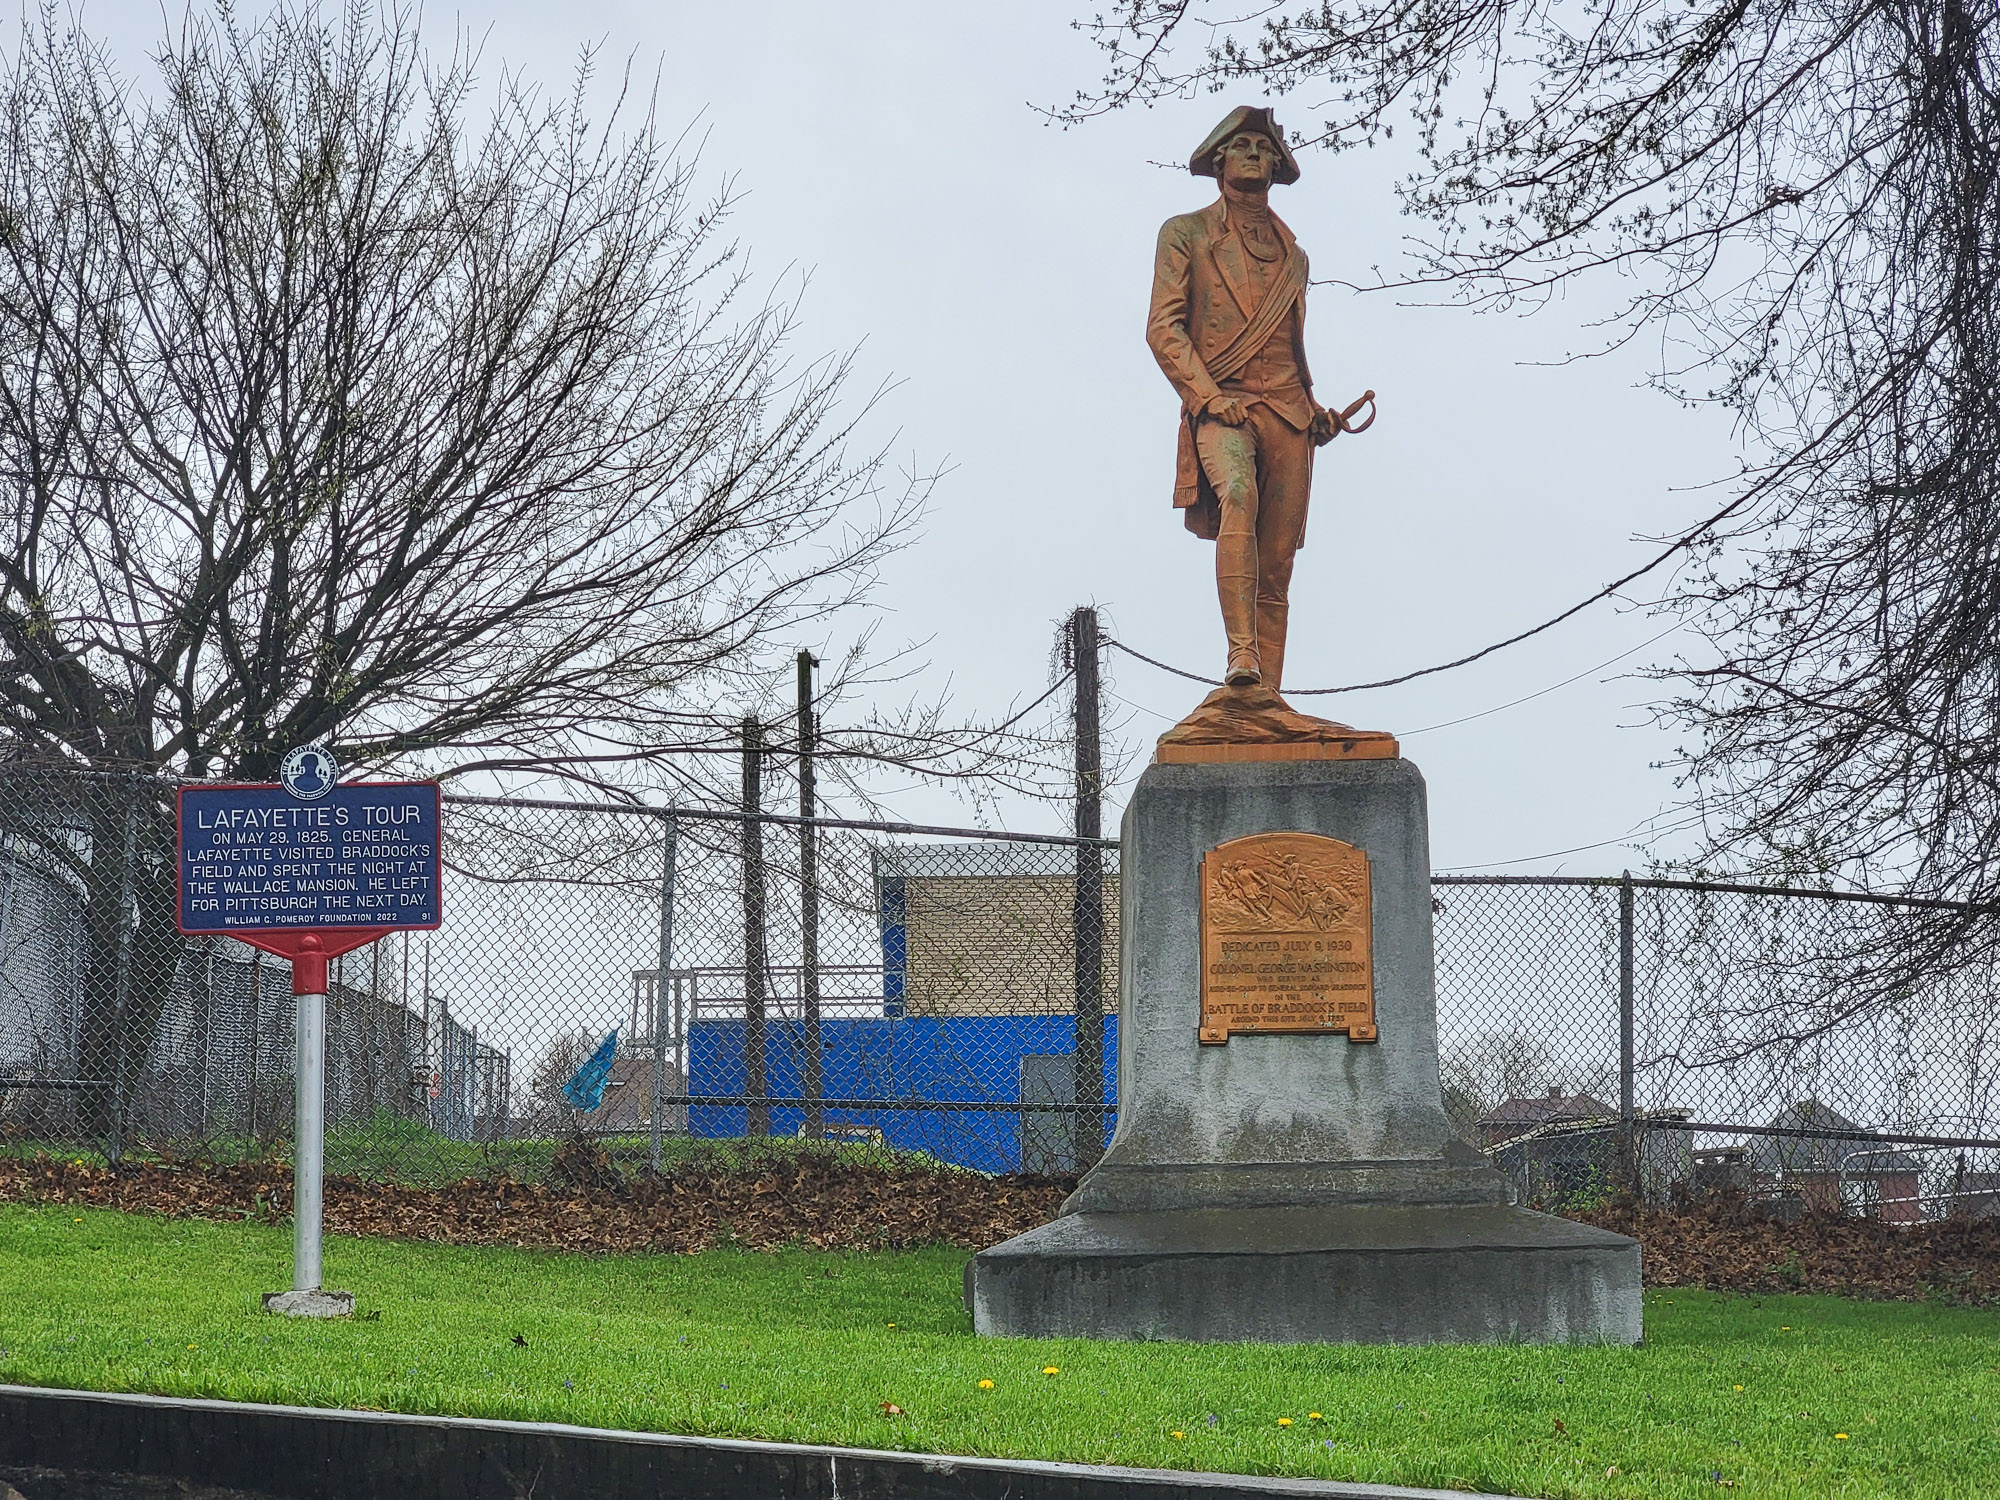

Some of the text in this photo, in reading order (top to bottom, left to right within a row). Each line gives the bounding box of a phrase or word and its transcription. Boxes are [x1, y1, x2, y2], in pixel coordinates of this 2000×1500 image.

[198, 804, 421, 829] LAFAYETTE'S TOUR
[212, 832, 231, 845] ON
[236, 831, 264, 844] MAY
[342, 829, 410, 842] GENERAL
[187, 844, 430, 862] LAFAYETTE VISITED BRADDOCK'S
[192, 861, 426, 878] FIELD AND SPENT THE NIGHT AT
[187, 876, 430, 895] THE WALLACE MANSION. HE LEFT
[191, 893, 427, 911] FOR PITTSBURGH THE NEXT DAY.
[225, 912, 398, 924] WILLIAM G. POMEROY FOUNDATION 2022
[421, 912, 431, 920] 91
[1221, 940, 1352, 952] DEDICATED JULY 9, 1930
[1210, 962, 1365, 974] COLONEL GEORGE WASHINGTON
[1331, 983, 1367, 991] BRADDOCK
[1208, 1002, 1368, 1014] BATTLE OF BRADDOCK'S FIELD
